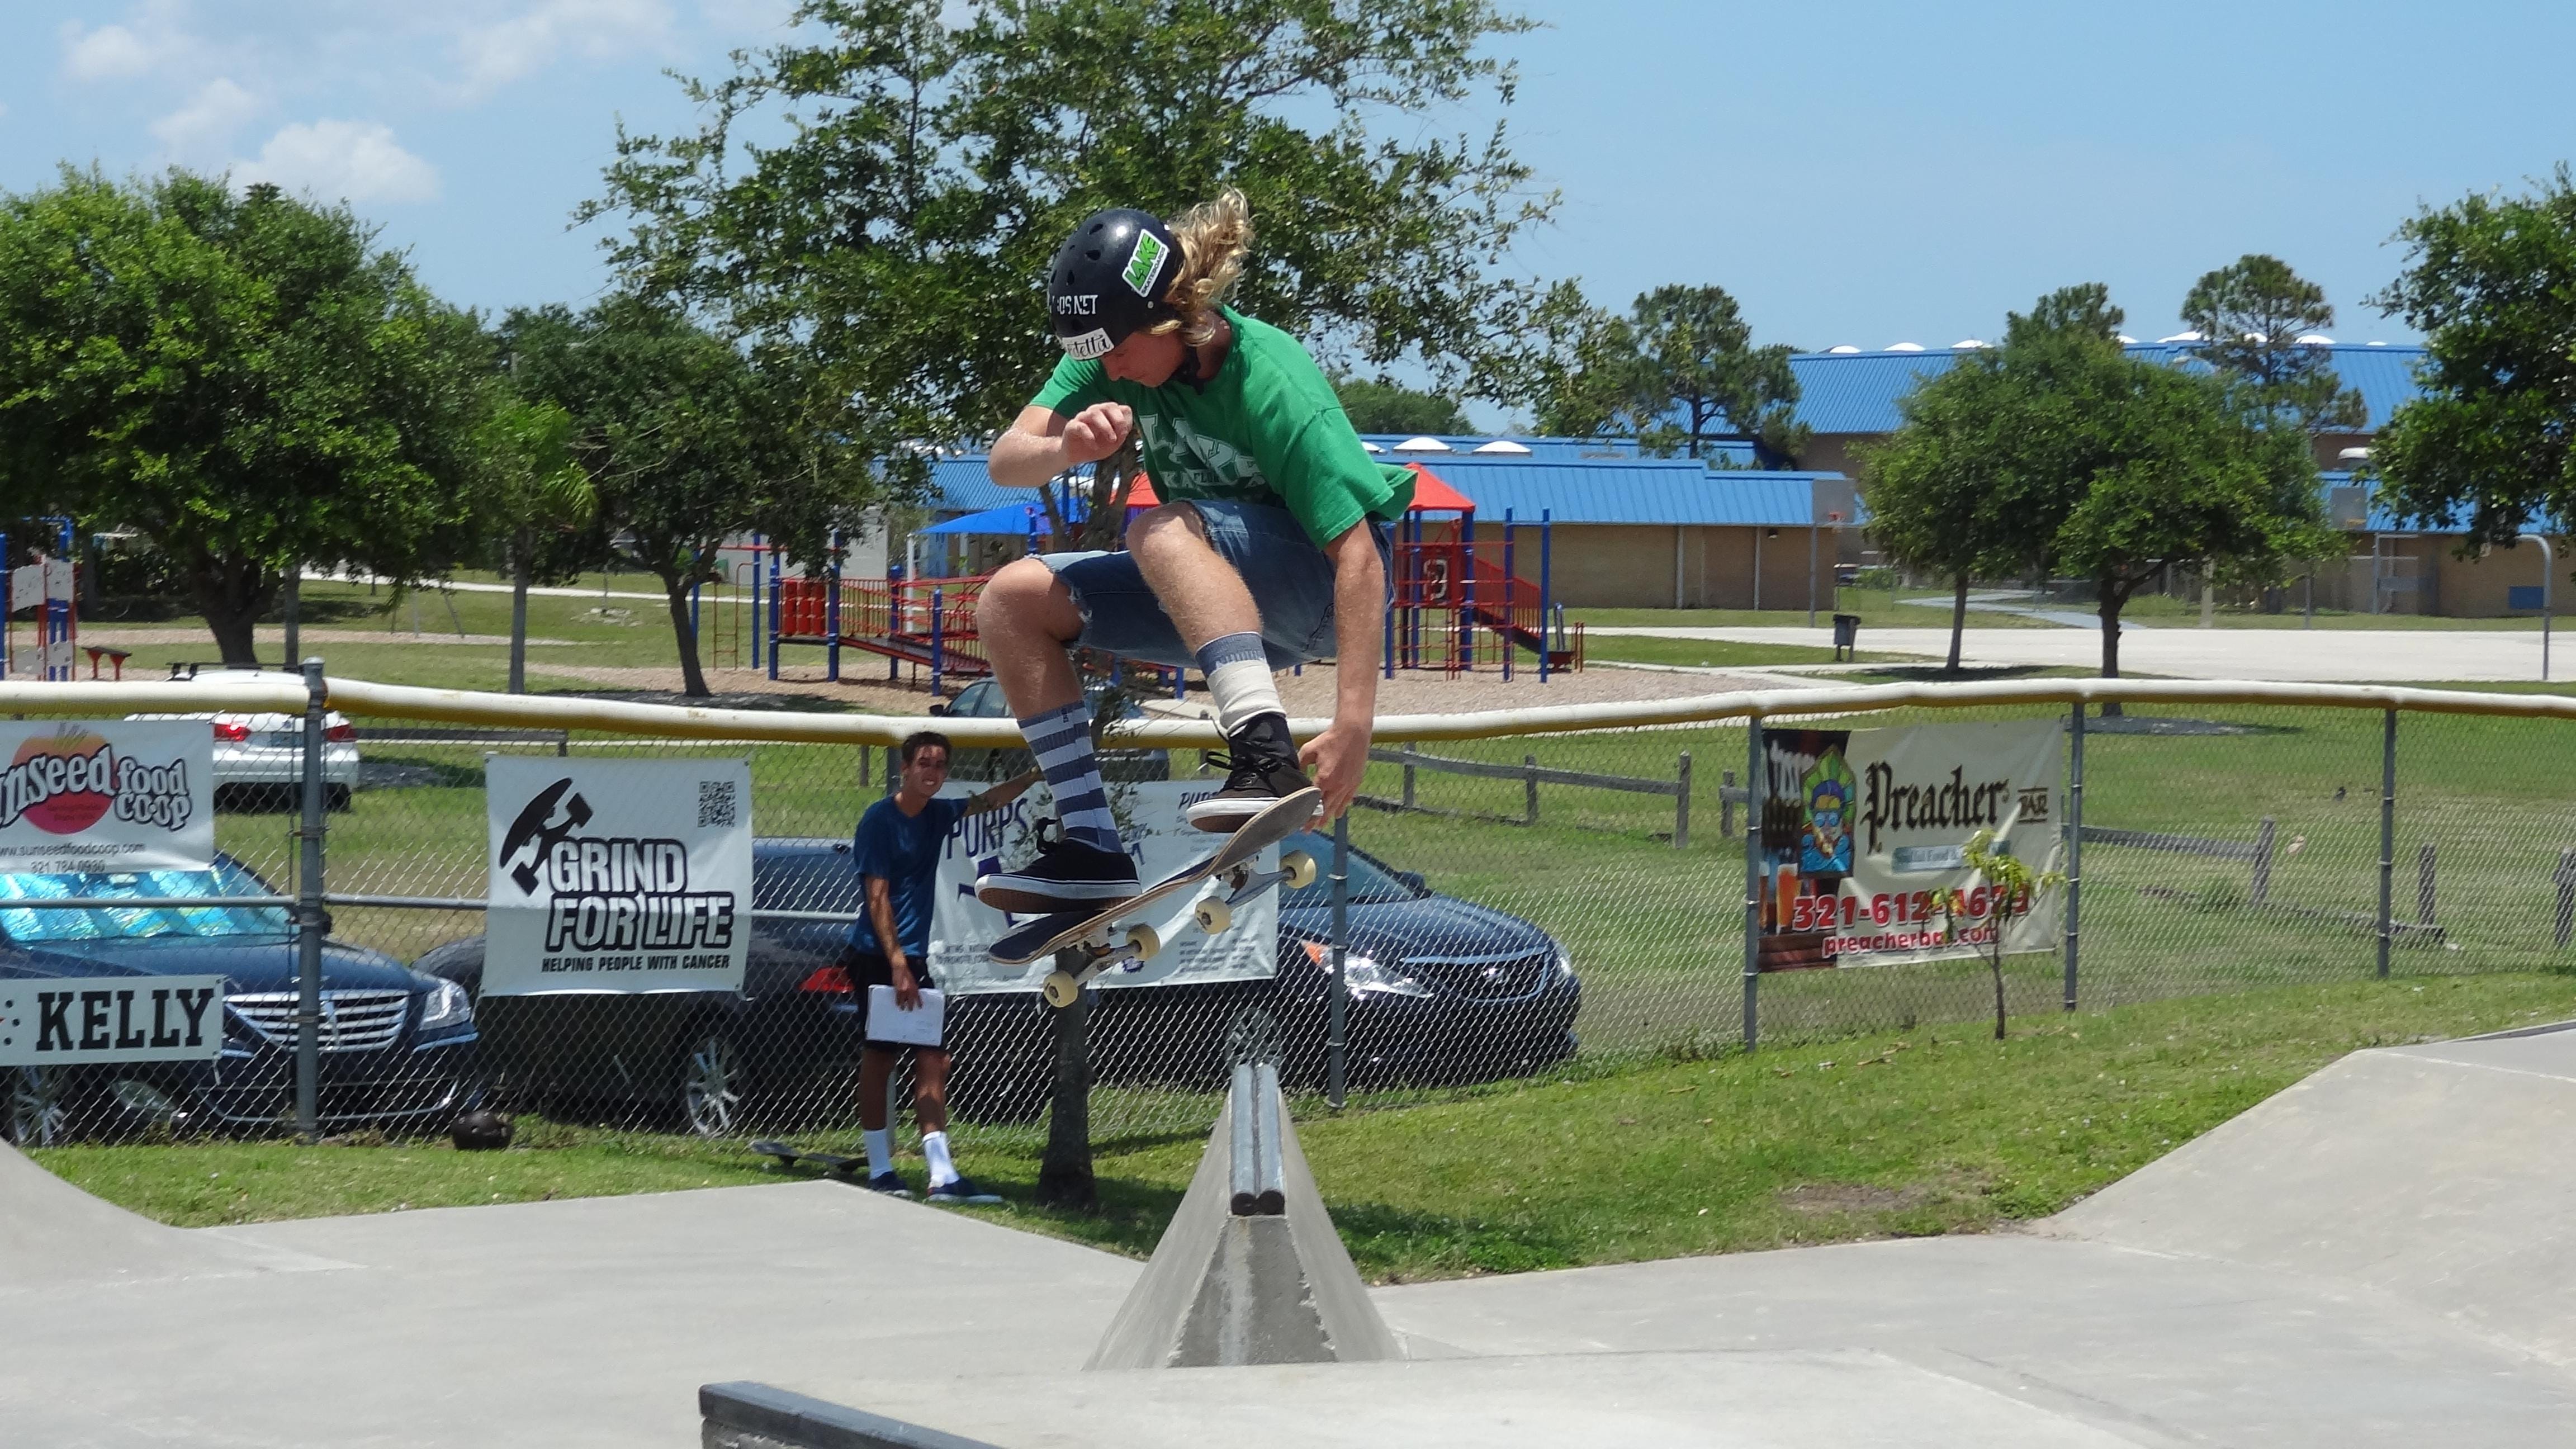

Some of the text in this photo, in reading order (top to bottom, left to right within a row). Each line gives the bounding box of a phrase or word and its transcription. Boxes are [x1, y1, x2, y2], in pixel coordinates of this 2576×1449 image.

[1125, 231, 1162, 290] LAKE
[116, 756, 189, 797] food
[548, 839, 686, 893] GRIND
[546, 893, 734, 951] FOR LIFE
[541, 954, 730, 972] HELPING PEOPLE WITH CANCER
[36, 988, 215, 1051] KELLY
